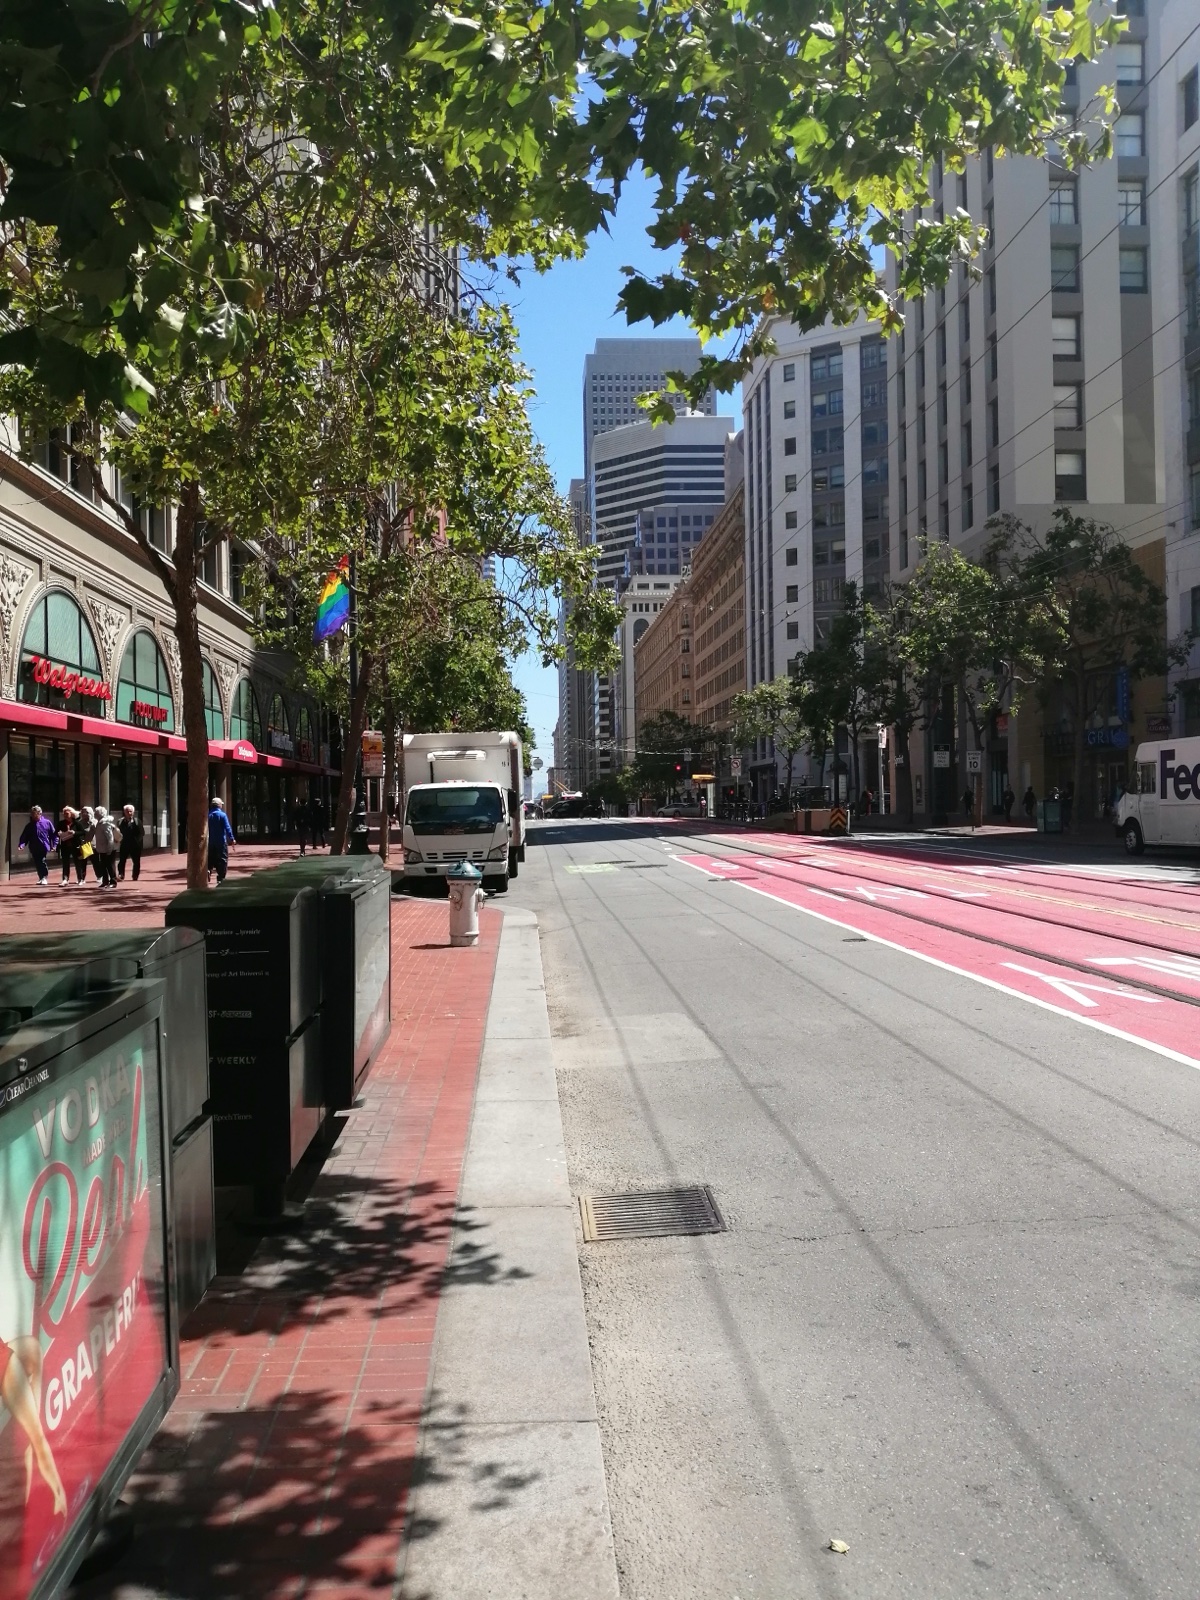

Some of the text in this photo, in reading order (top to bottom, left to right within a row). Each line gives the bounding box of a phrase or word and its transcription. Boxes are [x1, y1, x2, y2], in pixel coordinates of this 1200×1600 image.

[31, 655, 113, 700] Walgreens
[134, 700, 152, 718] FOOD
[969, 761, 979, 769] 10
[807, 884, 992, 902] TAXI
[216, 1056, 257, 1064] WEEKLY
[32, 1053, 131, 1160] VODKA
[213, 1113, 252, 1122] Epoch Times
[83, 1132, 106, 1168] MADE
